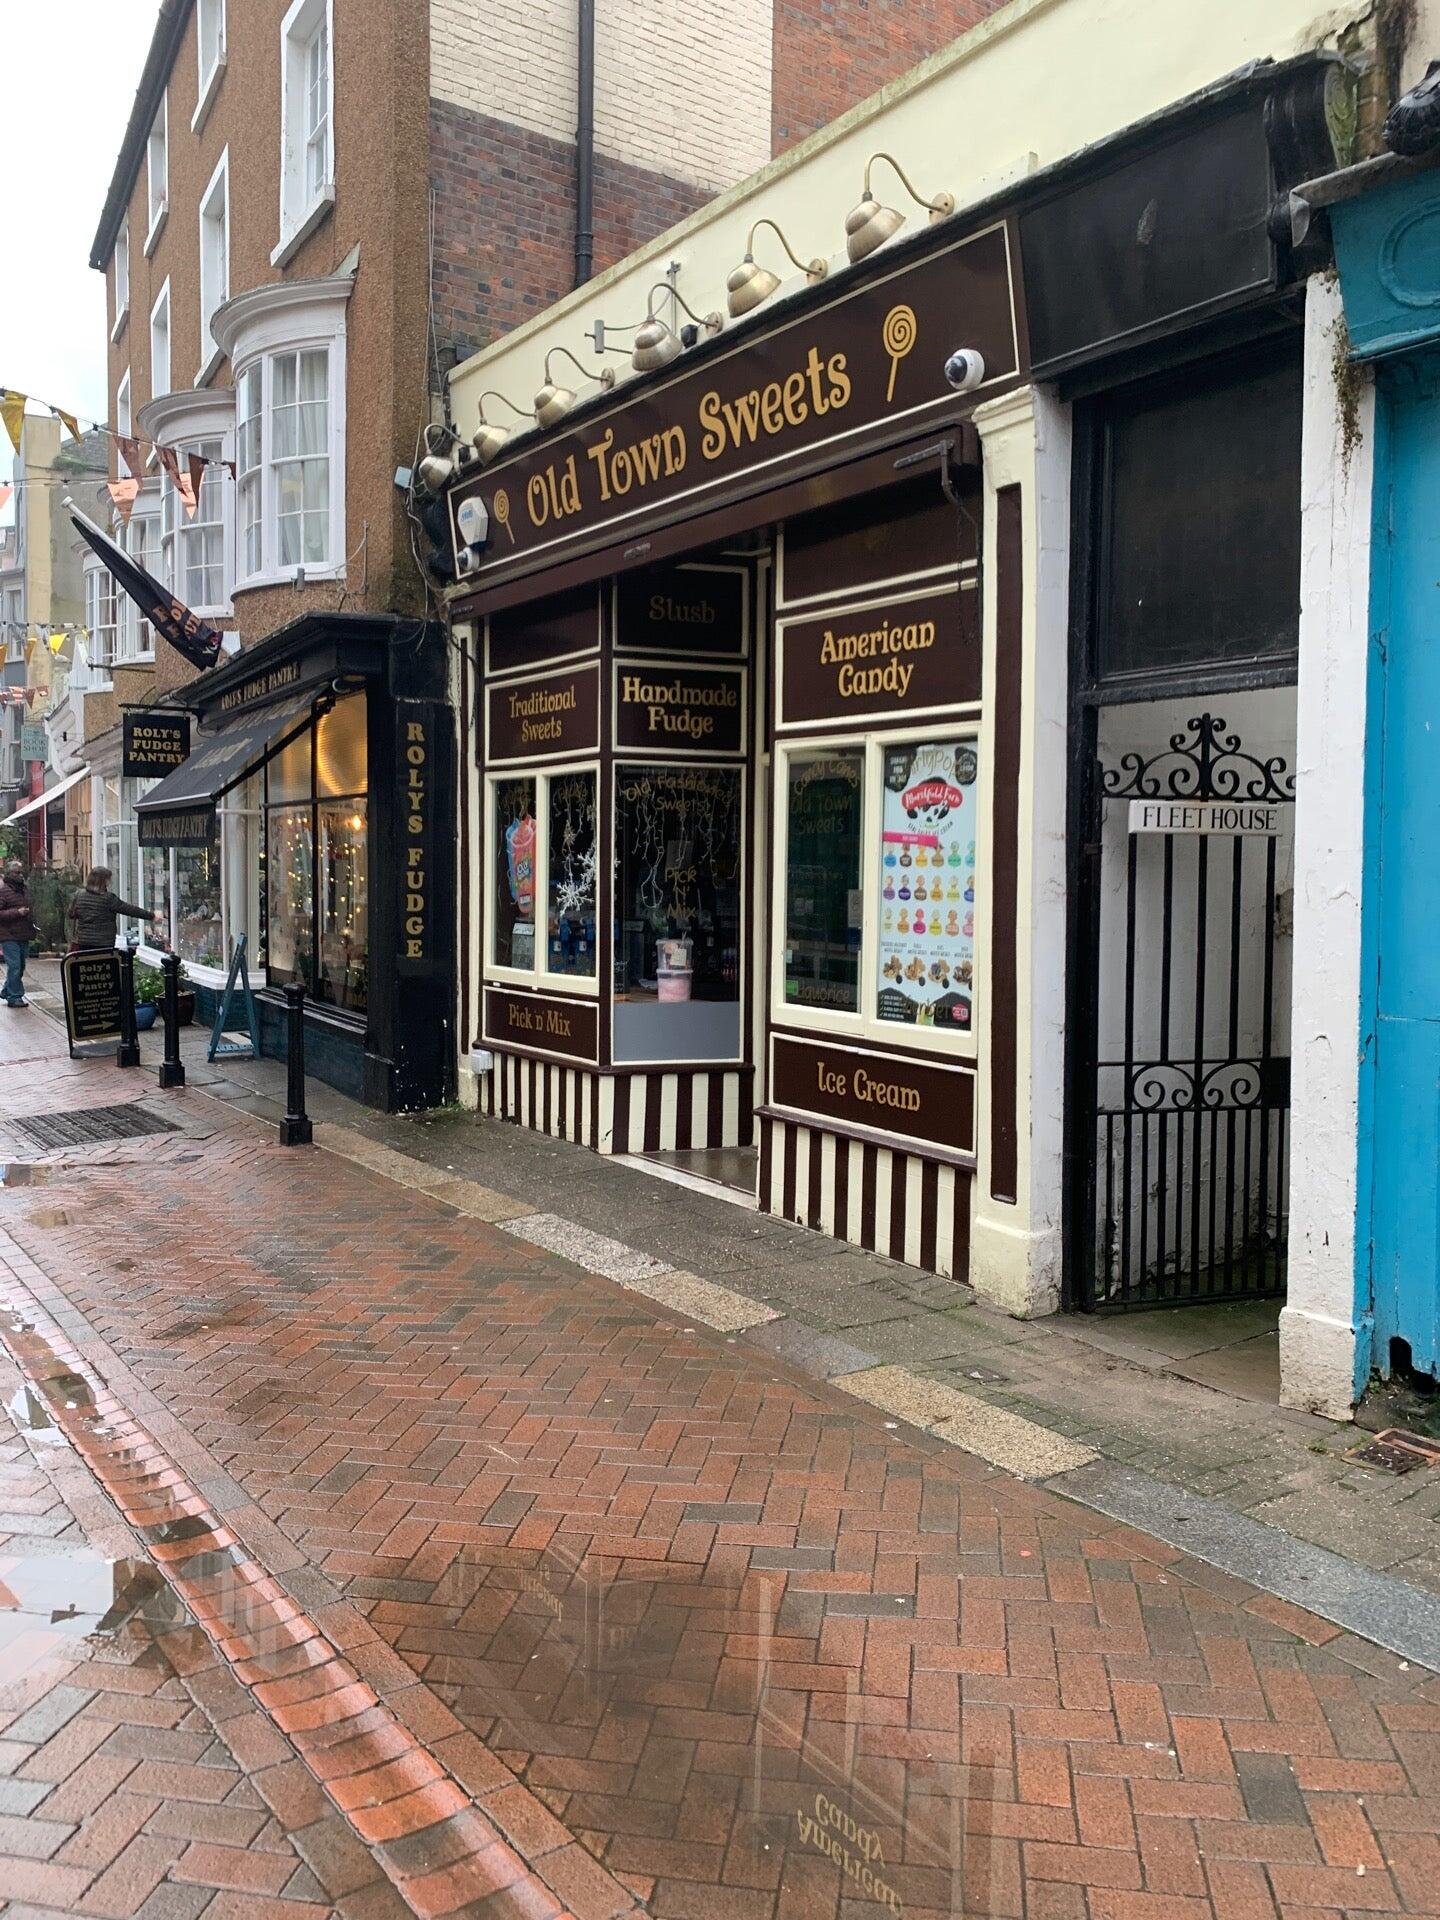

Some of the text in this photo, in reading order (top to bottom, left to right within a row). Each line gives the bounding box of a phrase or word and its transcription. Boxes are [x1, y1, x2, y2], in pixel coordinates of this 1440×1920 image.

[527, 346, 852, 527] Old Town Sweets
[649, 595, 715, 624] Slush
[820, 620, 936, 664] American
[838, 657, 914, 697] Candy
[508, 684, 577, 718] Traditional
[622, 676, 737, 707] Handmade
[133, 727, 181, 739] ROLY'S
[521, 716, 562, 742] Sweets
[648, 706, 714, 739] Fudge
[128, 751, 185, 764] PANTRY
[133, 740, 182, 752] FUDGE
[624, 778, 651, 801] Old
[816, 794, 852, 812] Town
[799, 816, 845, 834] Sweets
[1143, 806, 1278, 830] FLEET HOUSE
[665, 866, 697, 882] Pick
[406, 848, 425, 958] FUDGE
[666, 903, 696, 919] Mix
[79, 963, 111, 973] Roly's
[80, 973, 112, 982] Fudge
[78, 981, 114, 991] Pantry
[508, 1003, 533, 1030] Pick
[546, 1010, 571, 1037] Mix
[817, 1061, 921, 1112] Ice Cream
